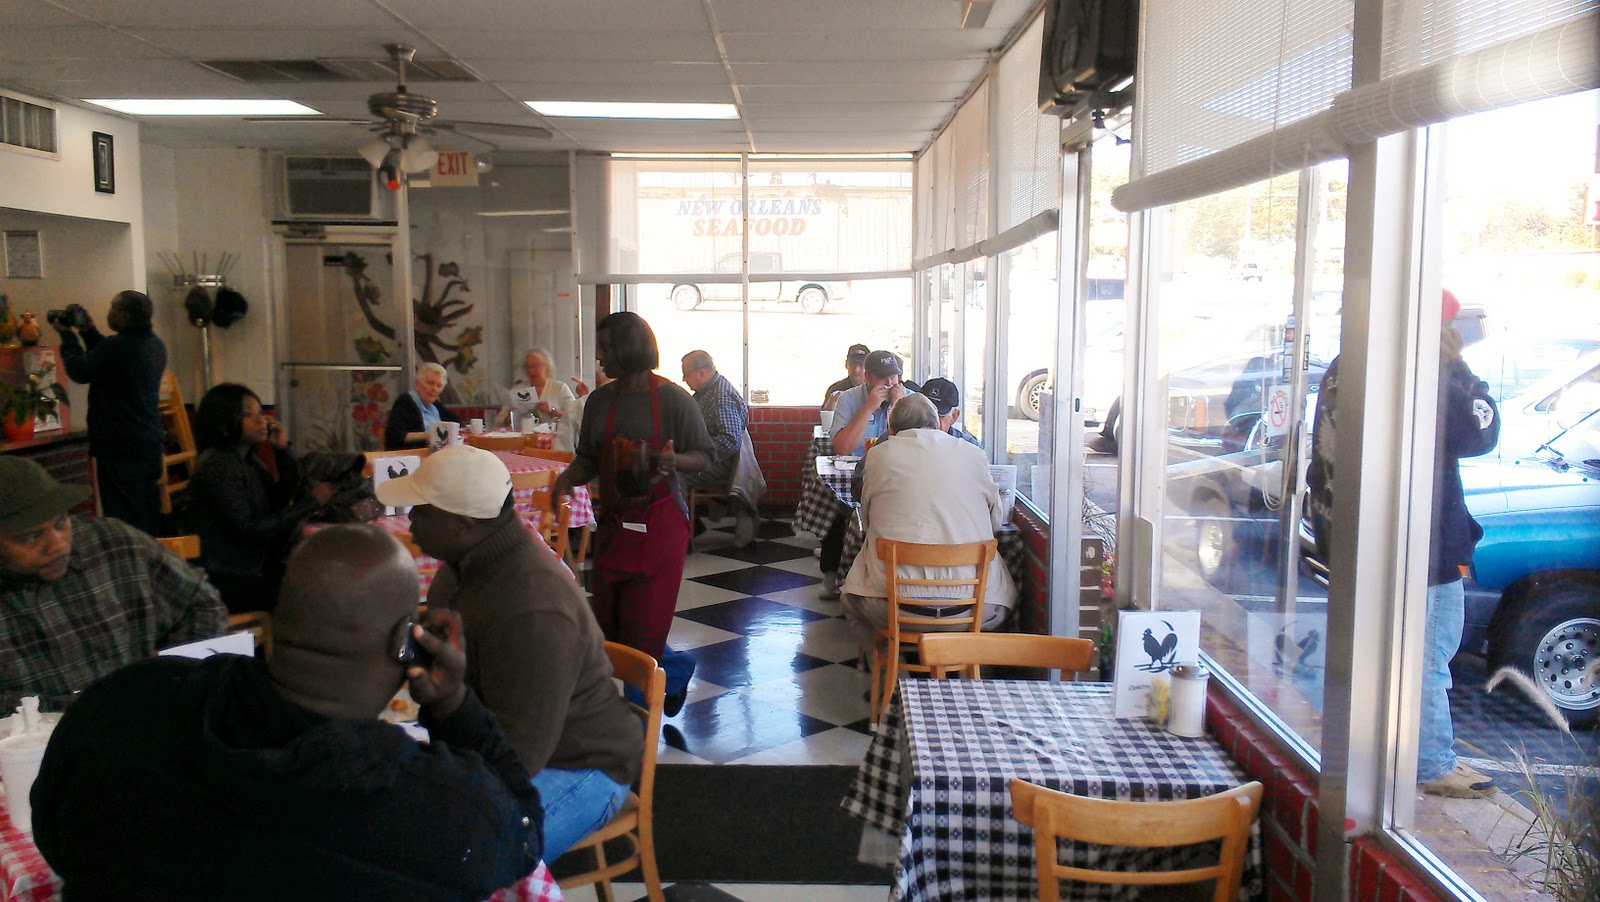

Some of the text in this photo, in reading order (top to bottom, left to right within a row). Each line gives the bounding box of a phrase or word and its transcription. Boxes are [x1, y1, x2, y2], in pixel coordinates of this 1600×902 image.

[437, 152, 468, 175] EXIT
[676, 198, 823, 216] NEW ORLEANS
